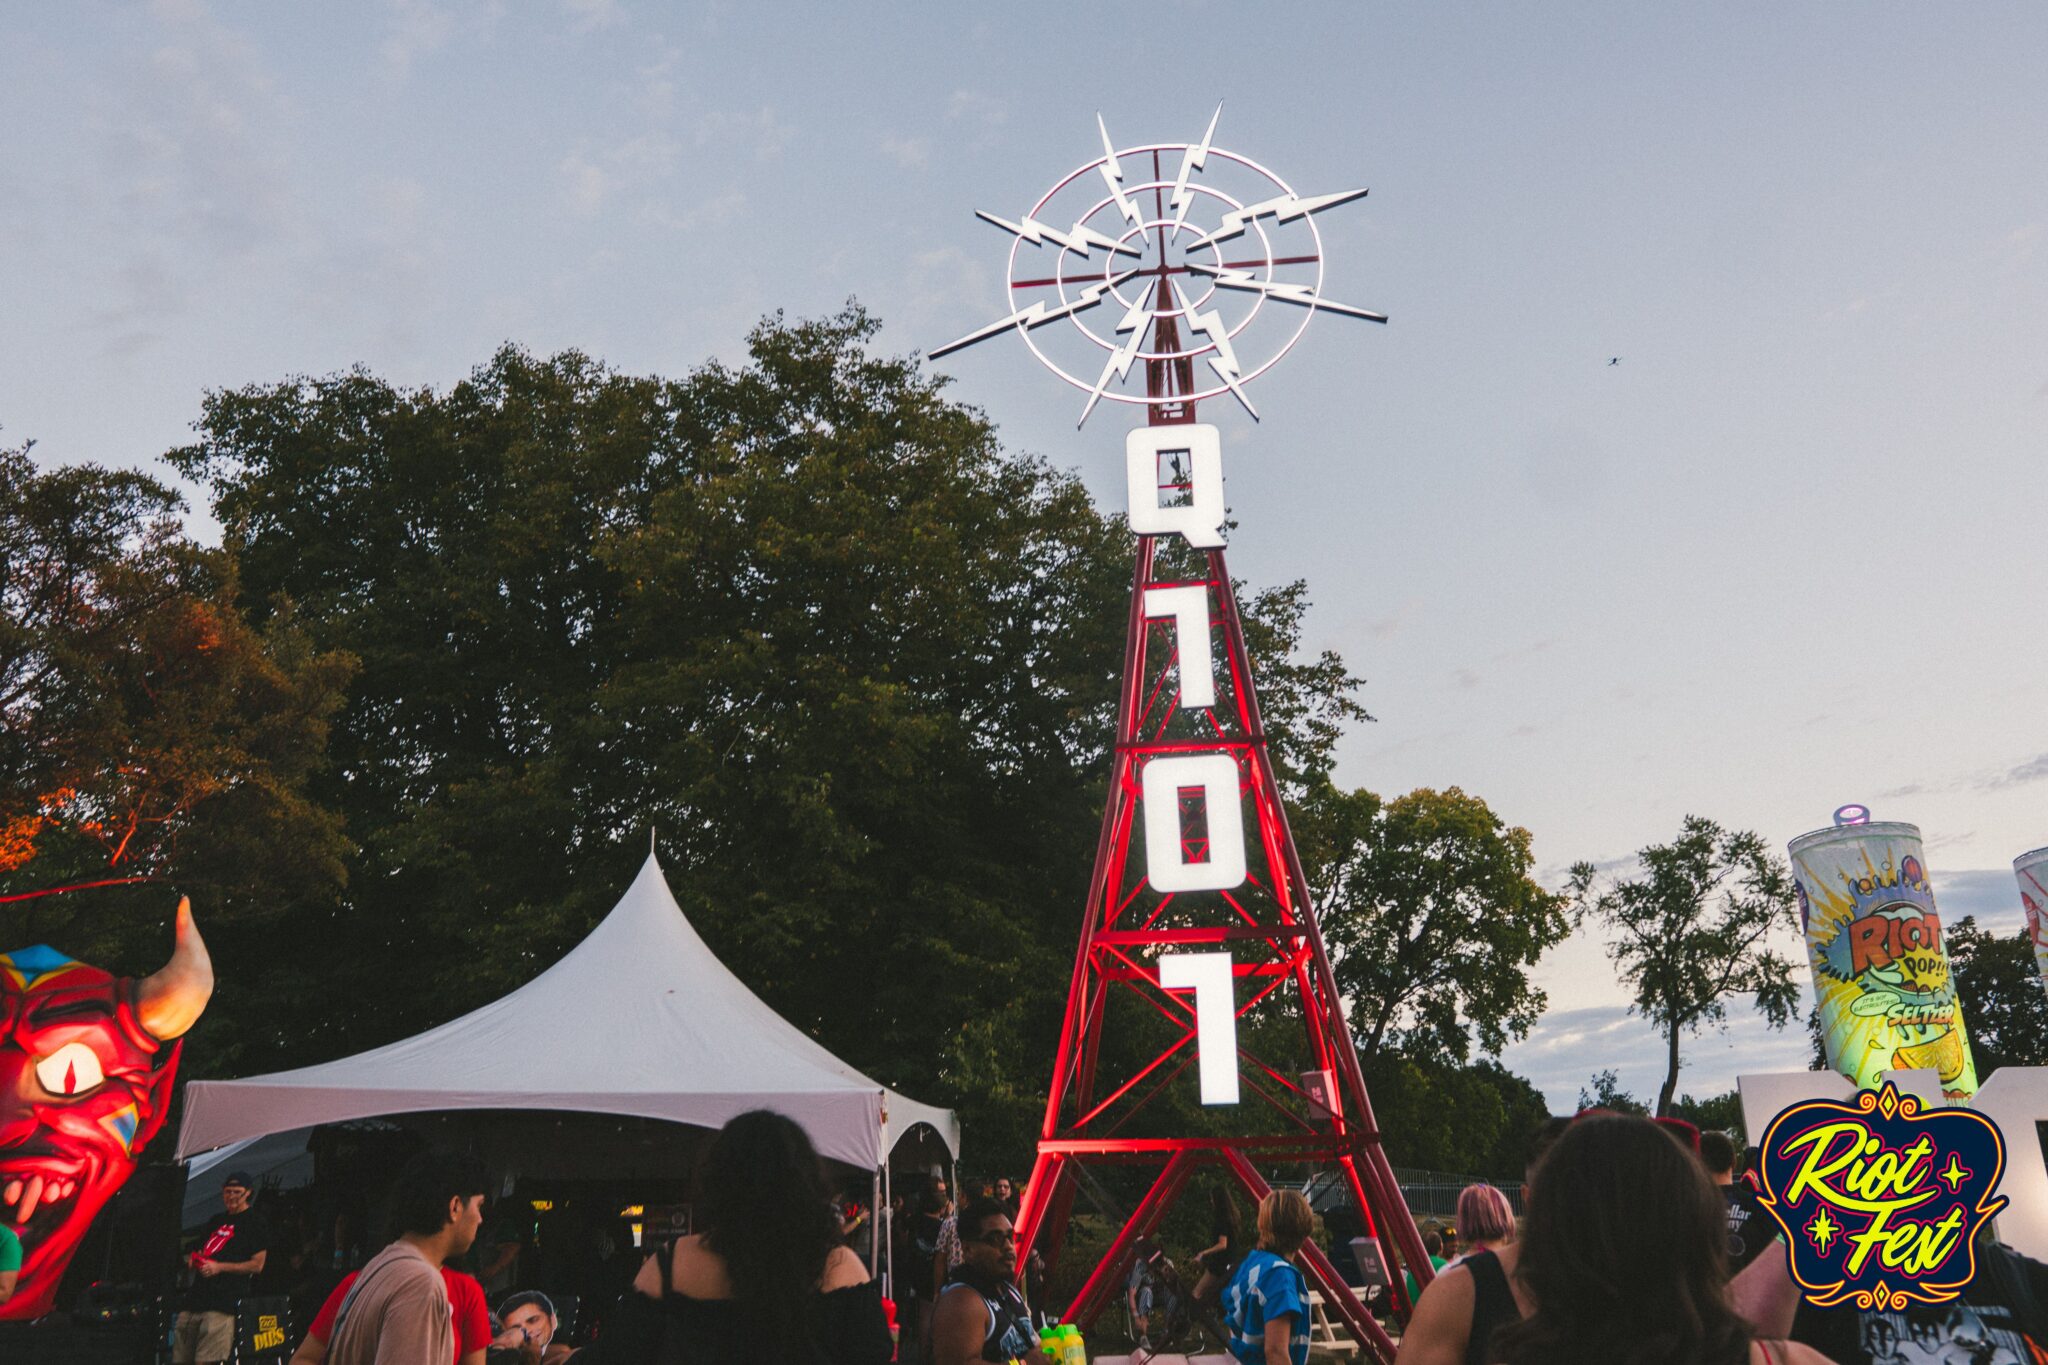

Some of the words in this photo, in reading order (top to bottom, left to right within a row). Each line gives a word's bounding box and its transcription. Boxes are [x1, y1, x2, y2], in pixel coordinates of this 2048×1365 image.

[1126, 423, 1247, 1105] Q101
[1849, 913, 1942, 974] RIOT
[1887, 1003, 1954, 1027] SELTZER
[254, 1327, 284, 1351] DIBS
